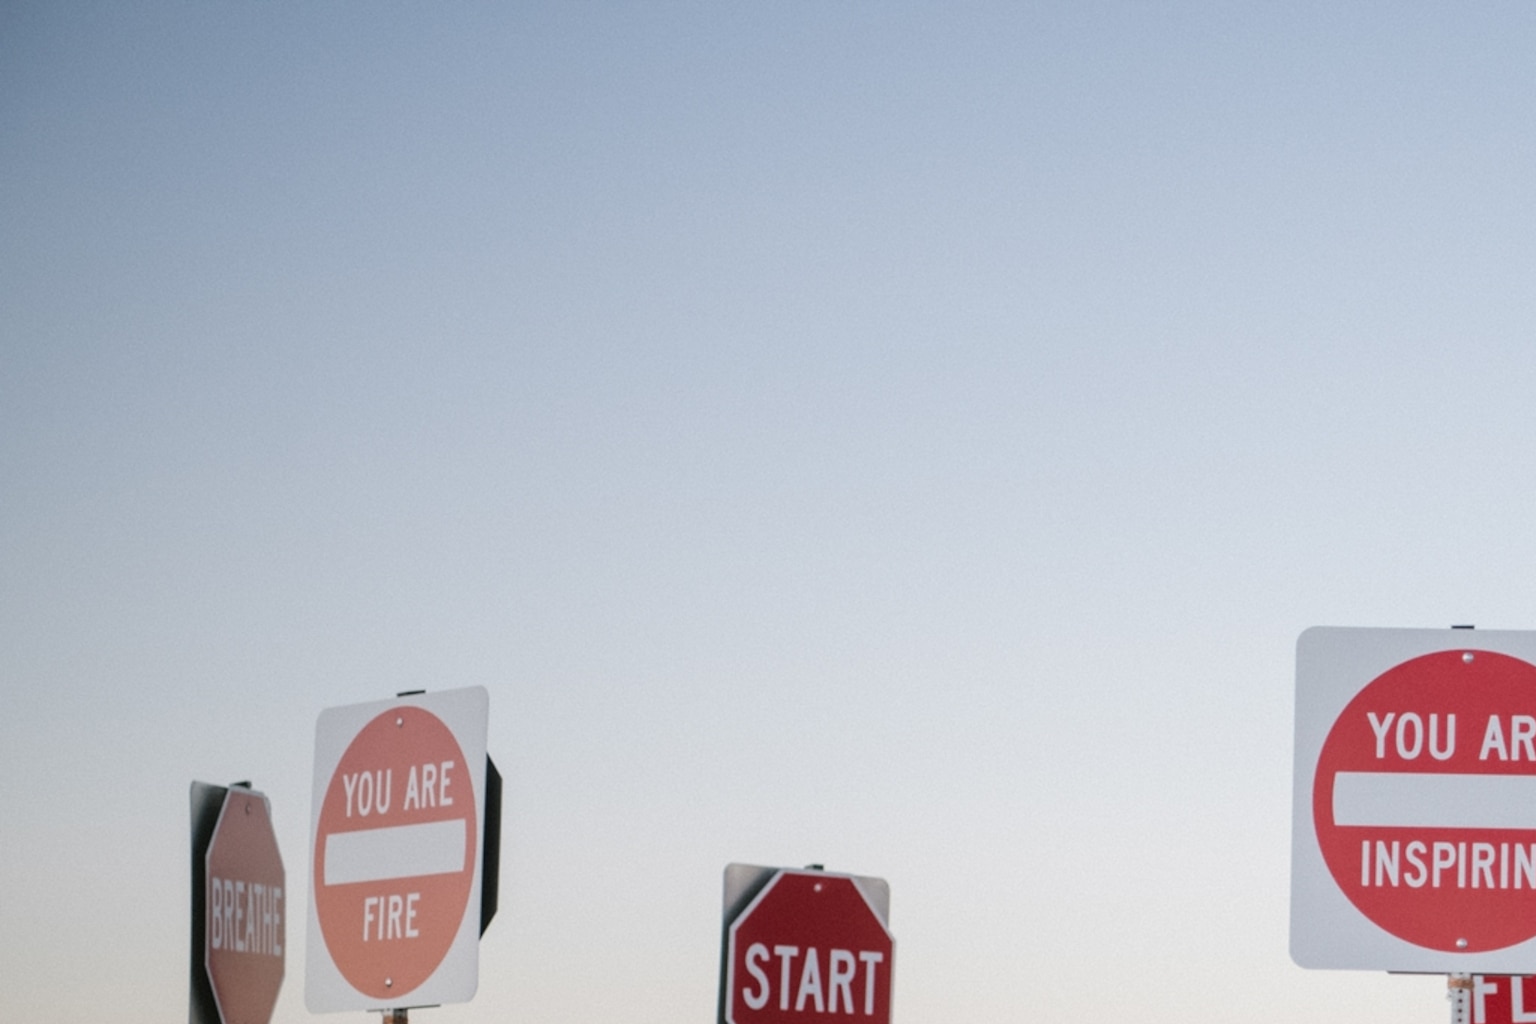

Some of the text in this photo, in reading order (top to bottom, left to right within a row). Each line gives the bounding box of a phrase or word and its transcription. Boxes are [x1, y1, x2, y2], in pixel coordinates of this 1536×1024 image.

[1366, 712, 1456, 760] YOU
[343, 760, 455, 818] YOU ARE
[211, 878, 282, 957] BREATHE
[363, 893, 420, 942] FIRE
[742, 942, 884, 1016] START
